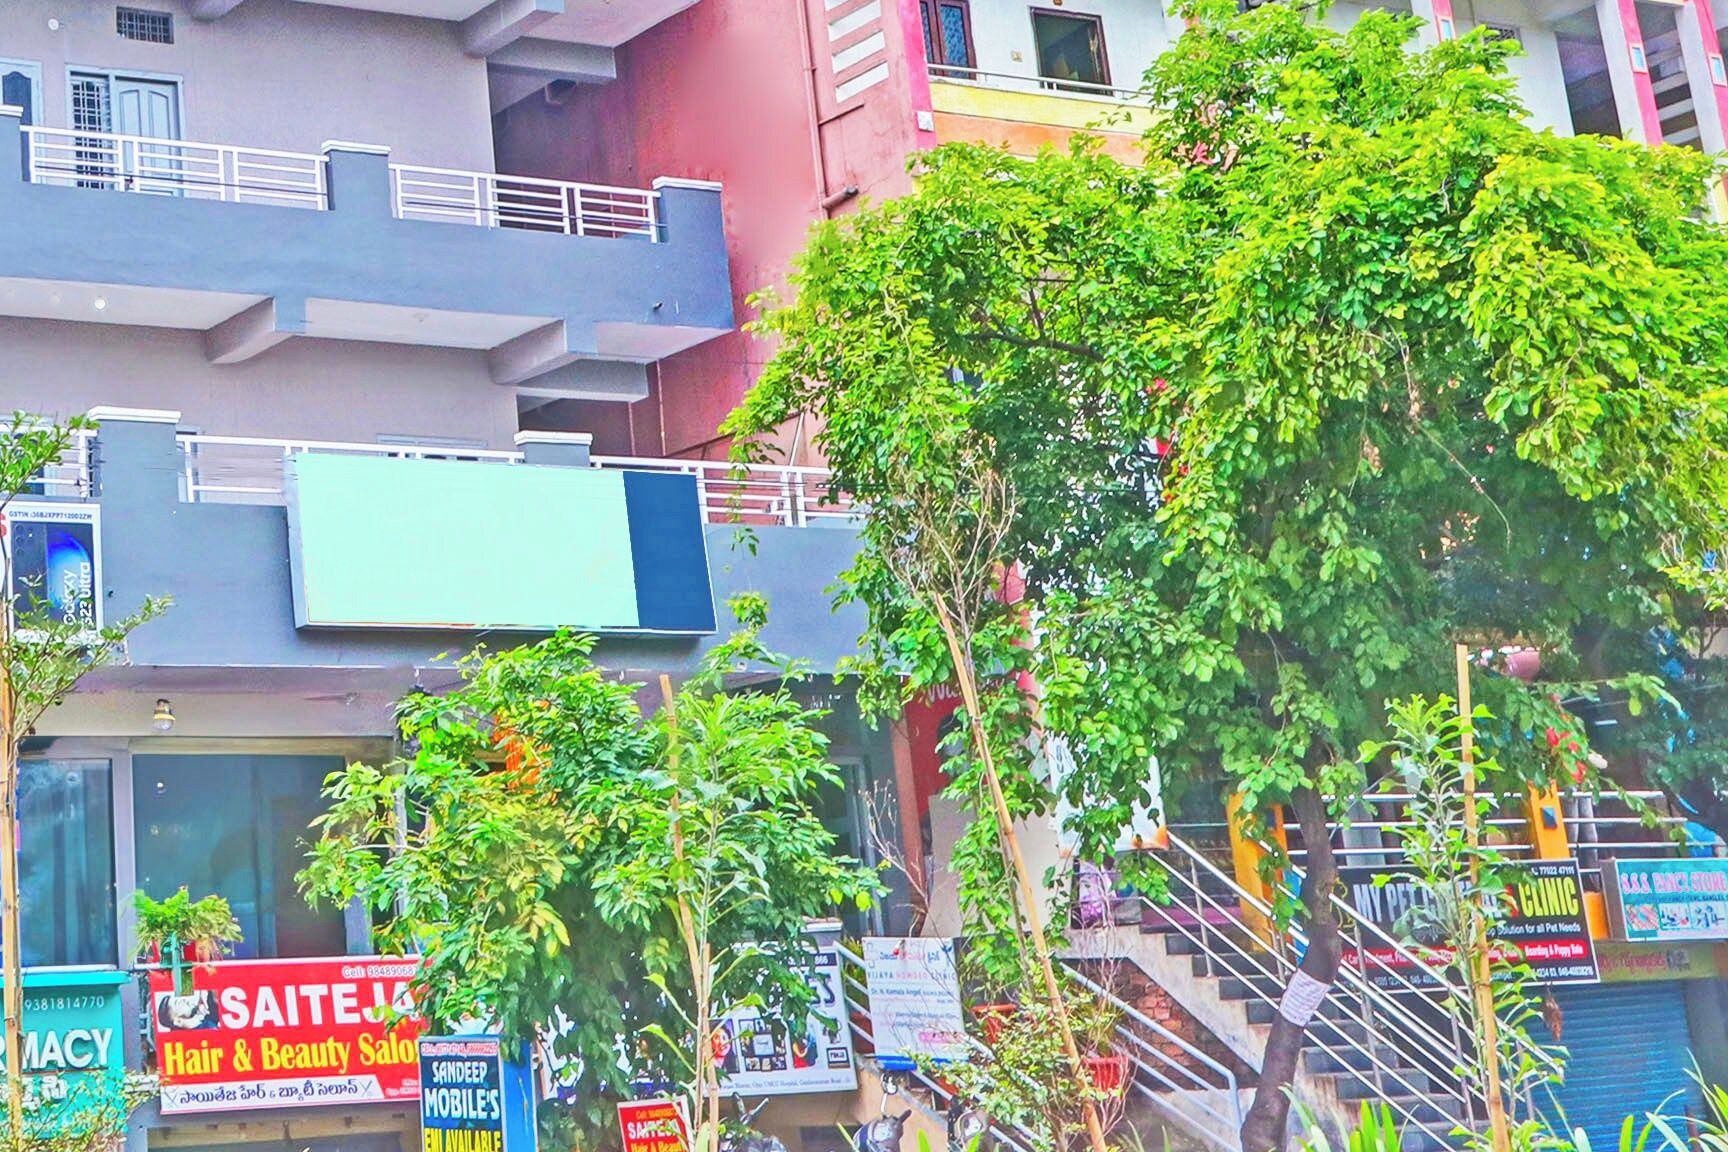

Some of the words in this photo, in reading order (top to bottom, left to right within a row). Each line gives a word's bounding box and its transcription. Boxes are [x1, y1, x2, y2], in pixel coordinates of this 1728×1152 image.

[78, 561, 92, 598] Ultra
[1353, 884, 1382, 922] MY
[1518, 876, 1580, 918] CLINIC
[1546, 922, 1558, 933] Pet
[1559, 922, 1581, 932] Needs
[24, 995, 104, 1010] 9381814770
[220, 981, 421, 1030] SAITEJA
[164, 1040, 224, 1077] Hair
[233, 1038, 254, 1073] &
[260, 1035, 351, 1075] Beauty
[432, 1061, 488, 1085] SANDEEP
[424, 1088, 501, 1120] MOBILE'S
[424, 1128, 443, 1152] EMI
[446, 1129, 502, 1152] AVAILABLE
